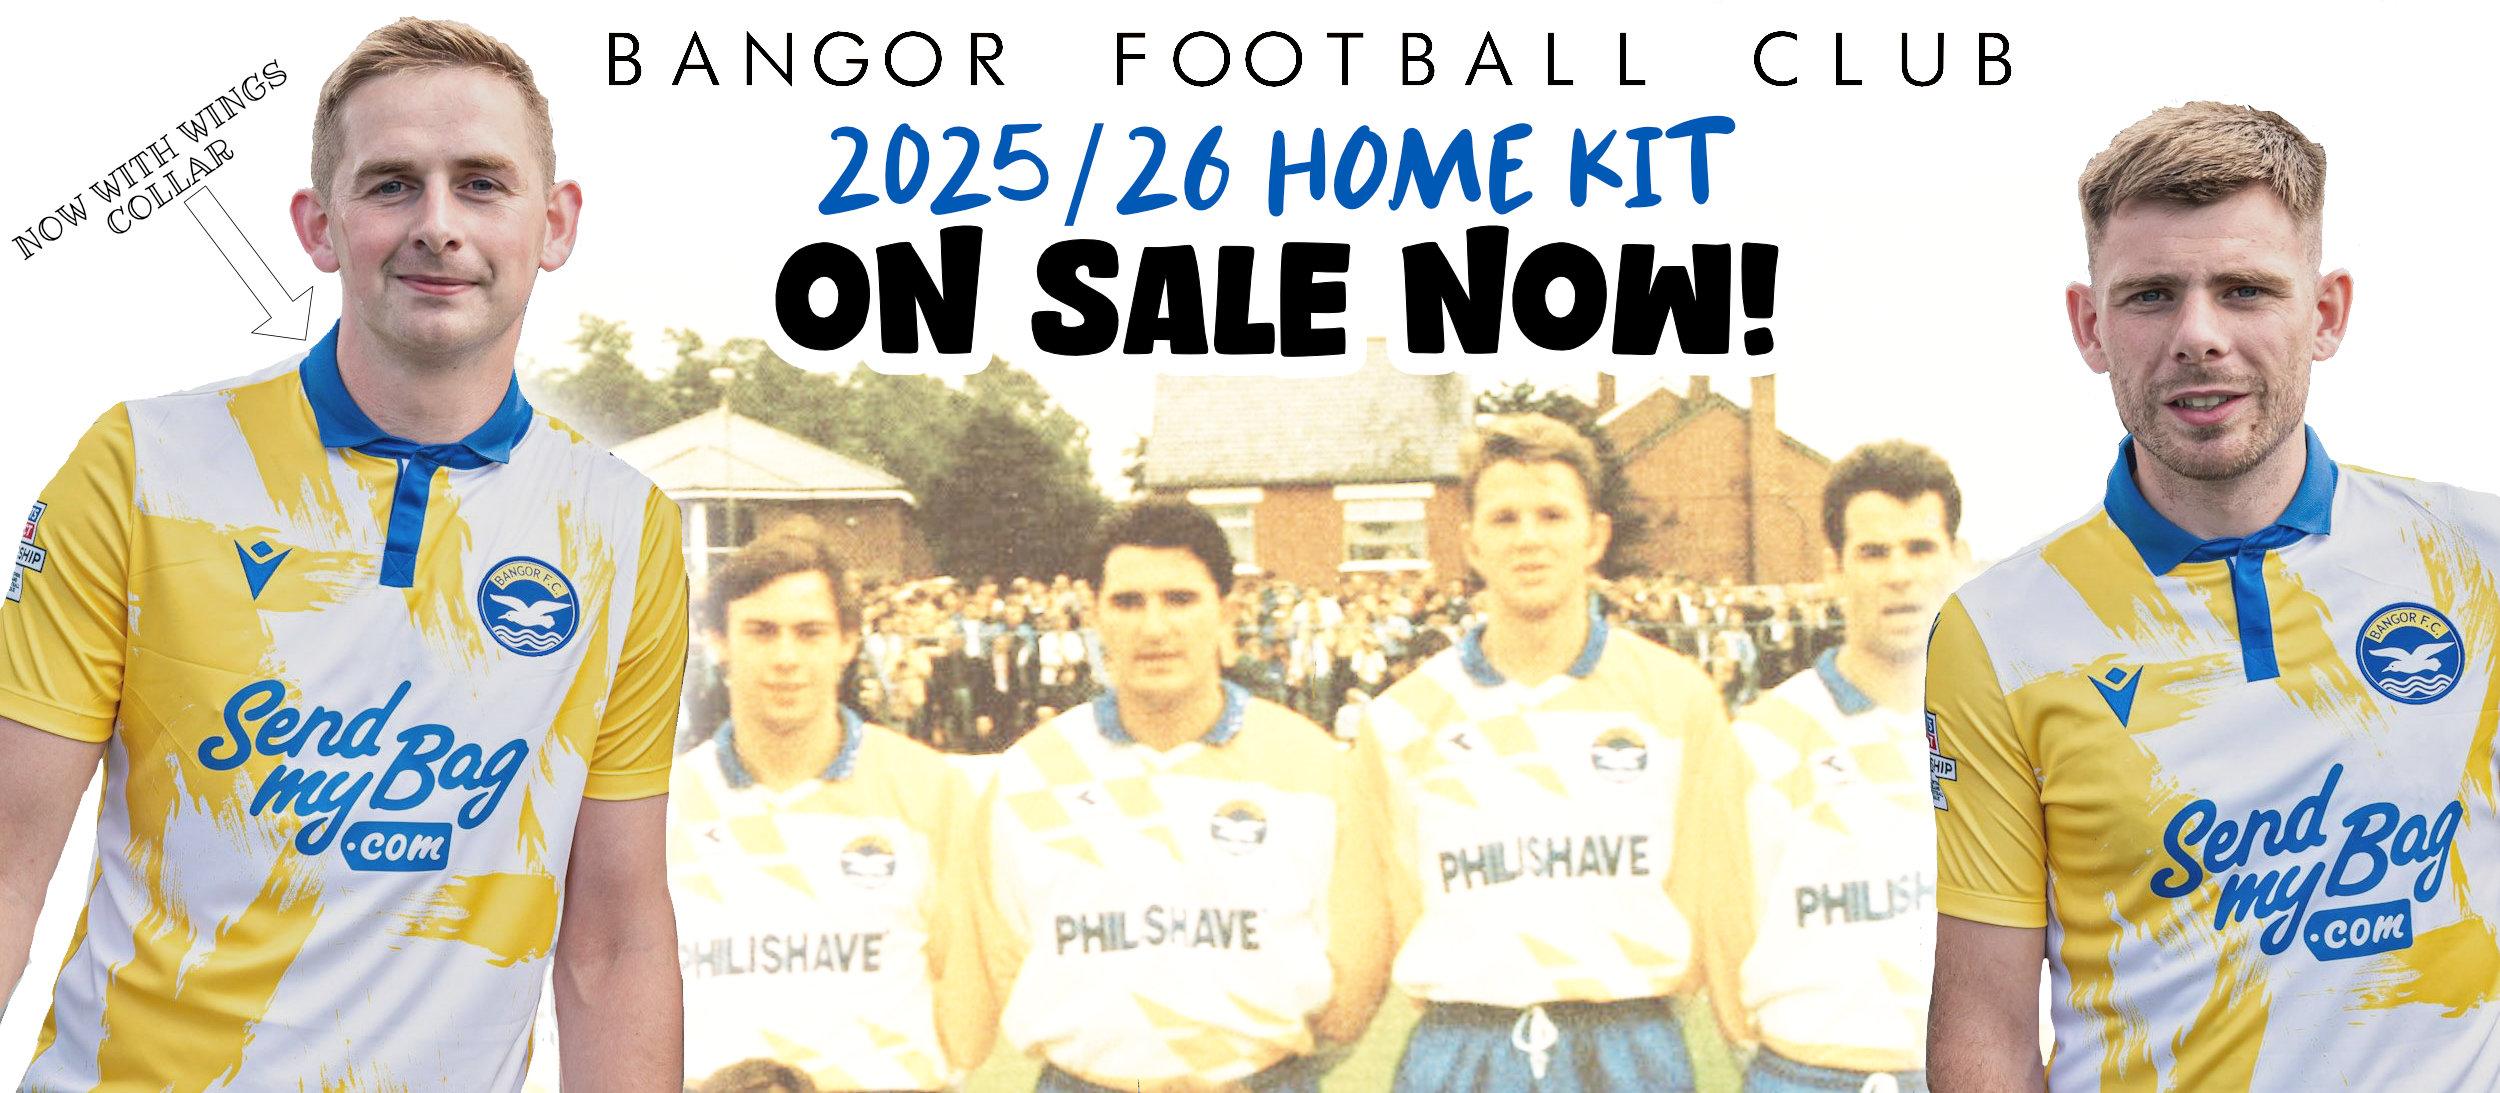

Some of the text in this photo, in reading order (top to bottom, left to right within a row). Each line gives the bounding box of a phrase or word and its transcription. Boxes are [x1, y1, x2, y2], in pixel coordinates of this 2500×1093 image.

[494, 565, 562, 596] BANGOR F.C.
[2369, 611, 2442, 640] BANGOR F.C.
[198, 679, 412, 771] Send
[249, 723, 530, 856] my Bag
[2150, 763, 2344, 898] Send
[2213, 800, 2464, 956] my Bag
